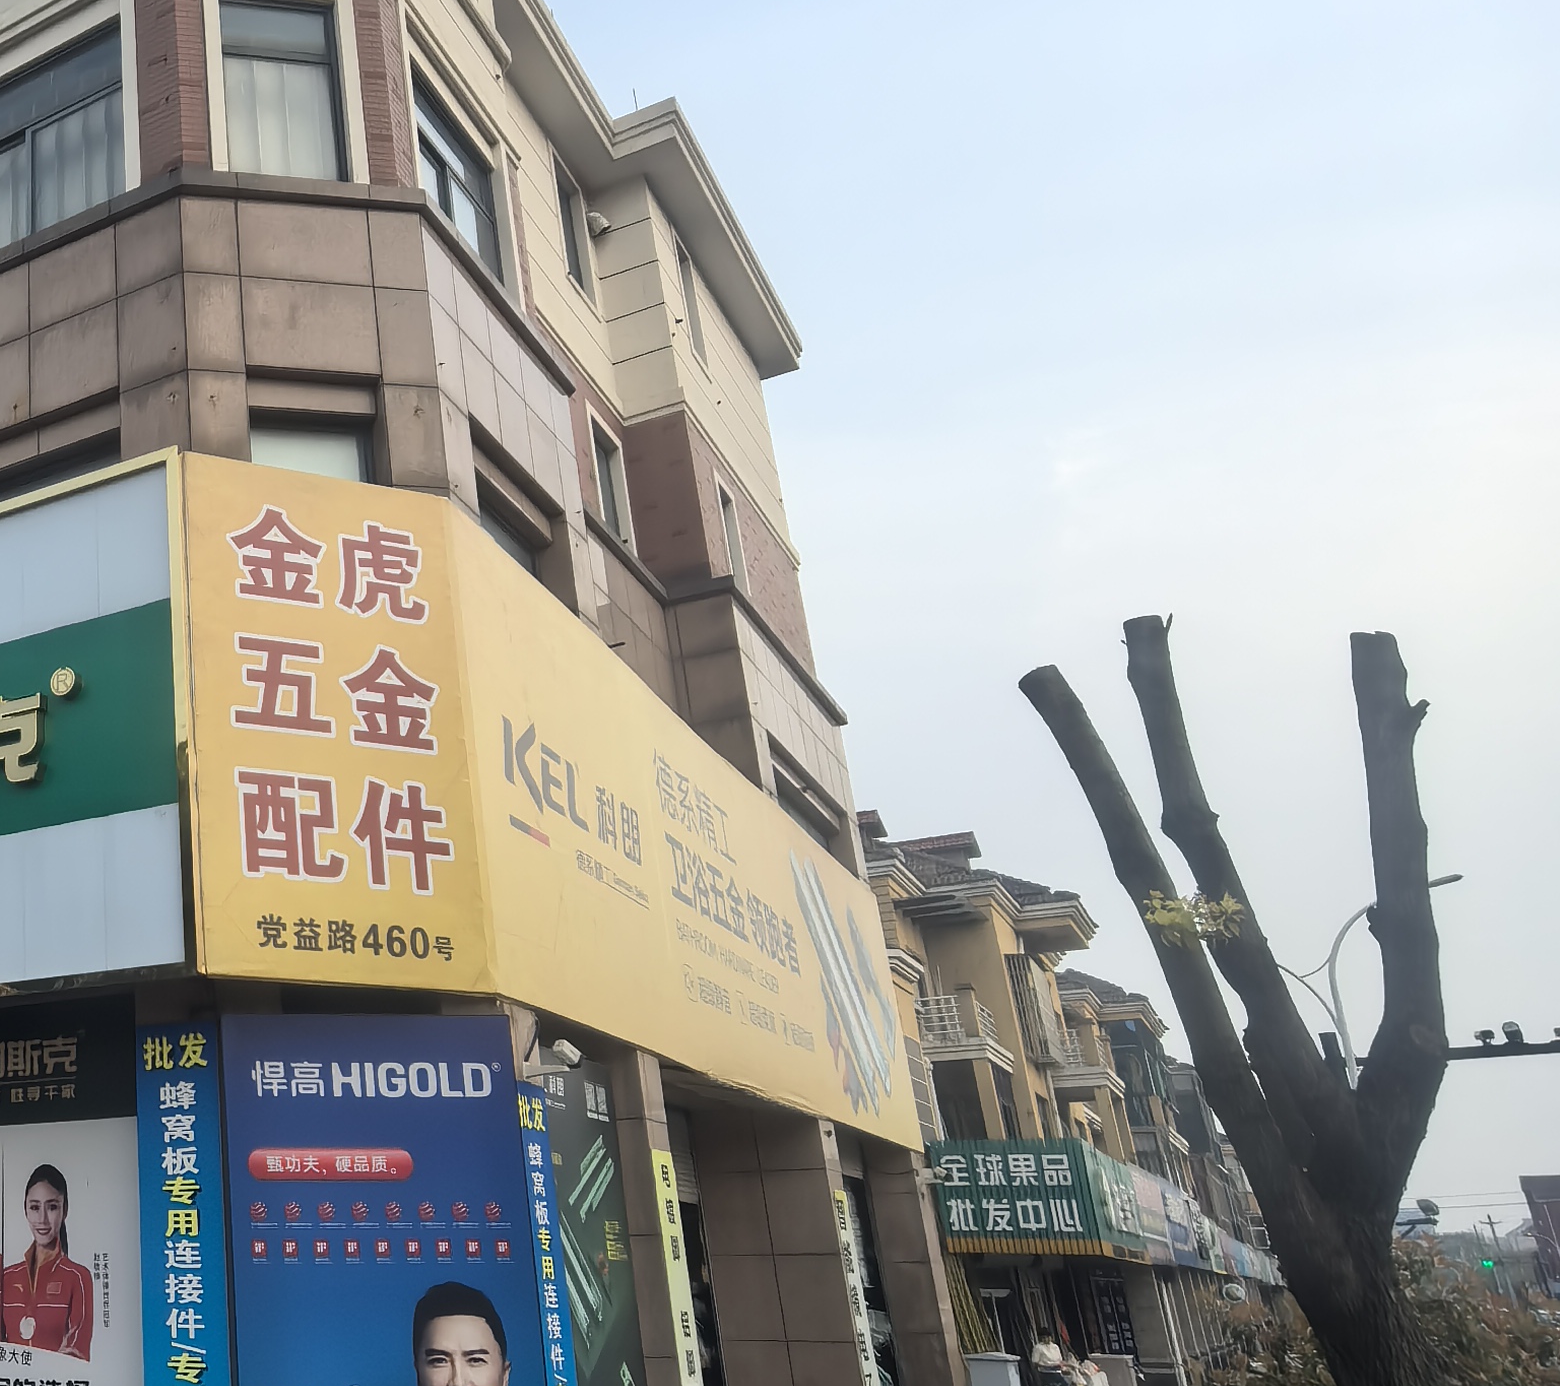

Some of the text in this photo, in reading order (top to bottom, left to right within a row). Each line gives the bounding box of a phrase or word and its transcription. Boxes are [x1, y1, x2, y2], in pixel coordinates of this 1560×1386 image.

[227, 505, 429, 624] 金虎
[230, 631, 438, 755] 五金
[235, 766, 453, 896] 配件
[501, 714, 642, 866] KEL 科朗
[653, 747, 737, 866] 德系精工
[256, 913, 454, 962] 党益路460号
[664, 831, 801, 978] 卫浴五金领跑者
[143, 1031, 207, 1072] 批发
[251, 1060, 492, 1098] 悍高 HIGOLD
[518, 1092, 546, 1133] 批发
[940, 1153, 1073, 1187] 全球果品
[946, 1198, 1084, 1233] 批发中心
